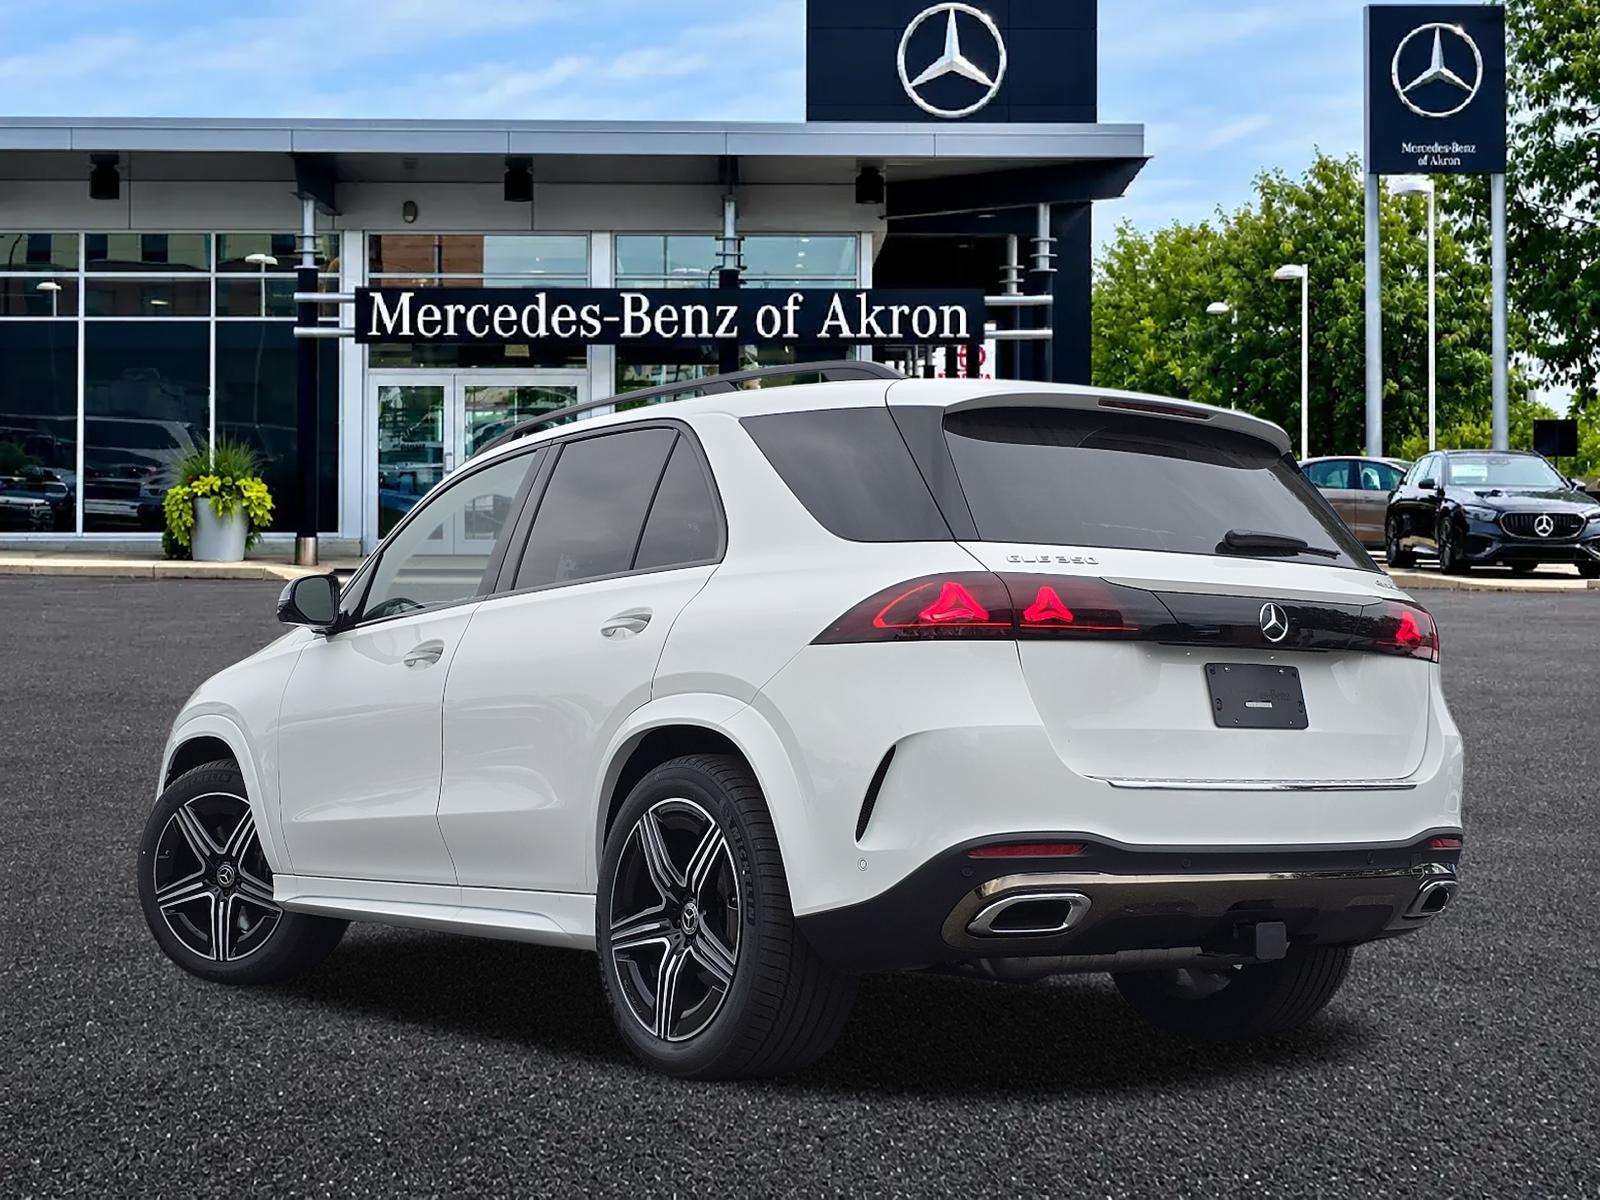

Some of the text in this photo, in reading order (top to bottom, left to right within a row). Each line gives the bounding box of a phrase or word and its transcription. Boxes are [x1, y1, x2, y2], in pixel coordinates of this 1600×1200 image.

[1401, 142, 1476, 153] Mercedes-Benz
[1418, 154, 1461, 166] of Akron
[368, 292, 970, 339] Mercedes-Benz of Akron
[1006, 554, 1100, 565] GLE 350
